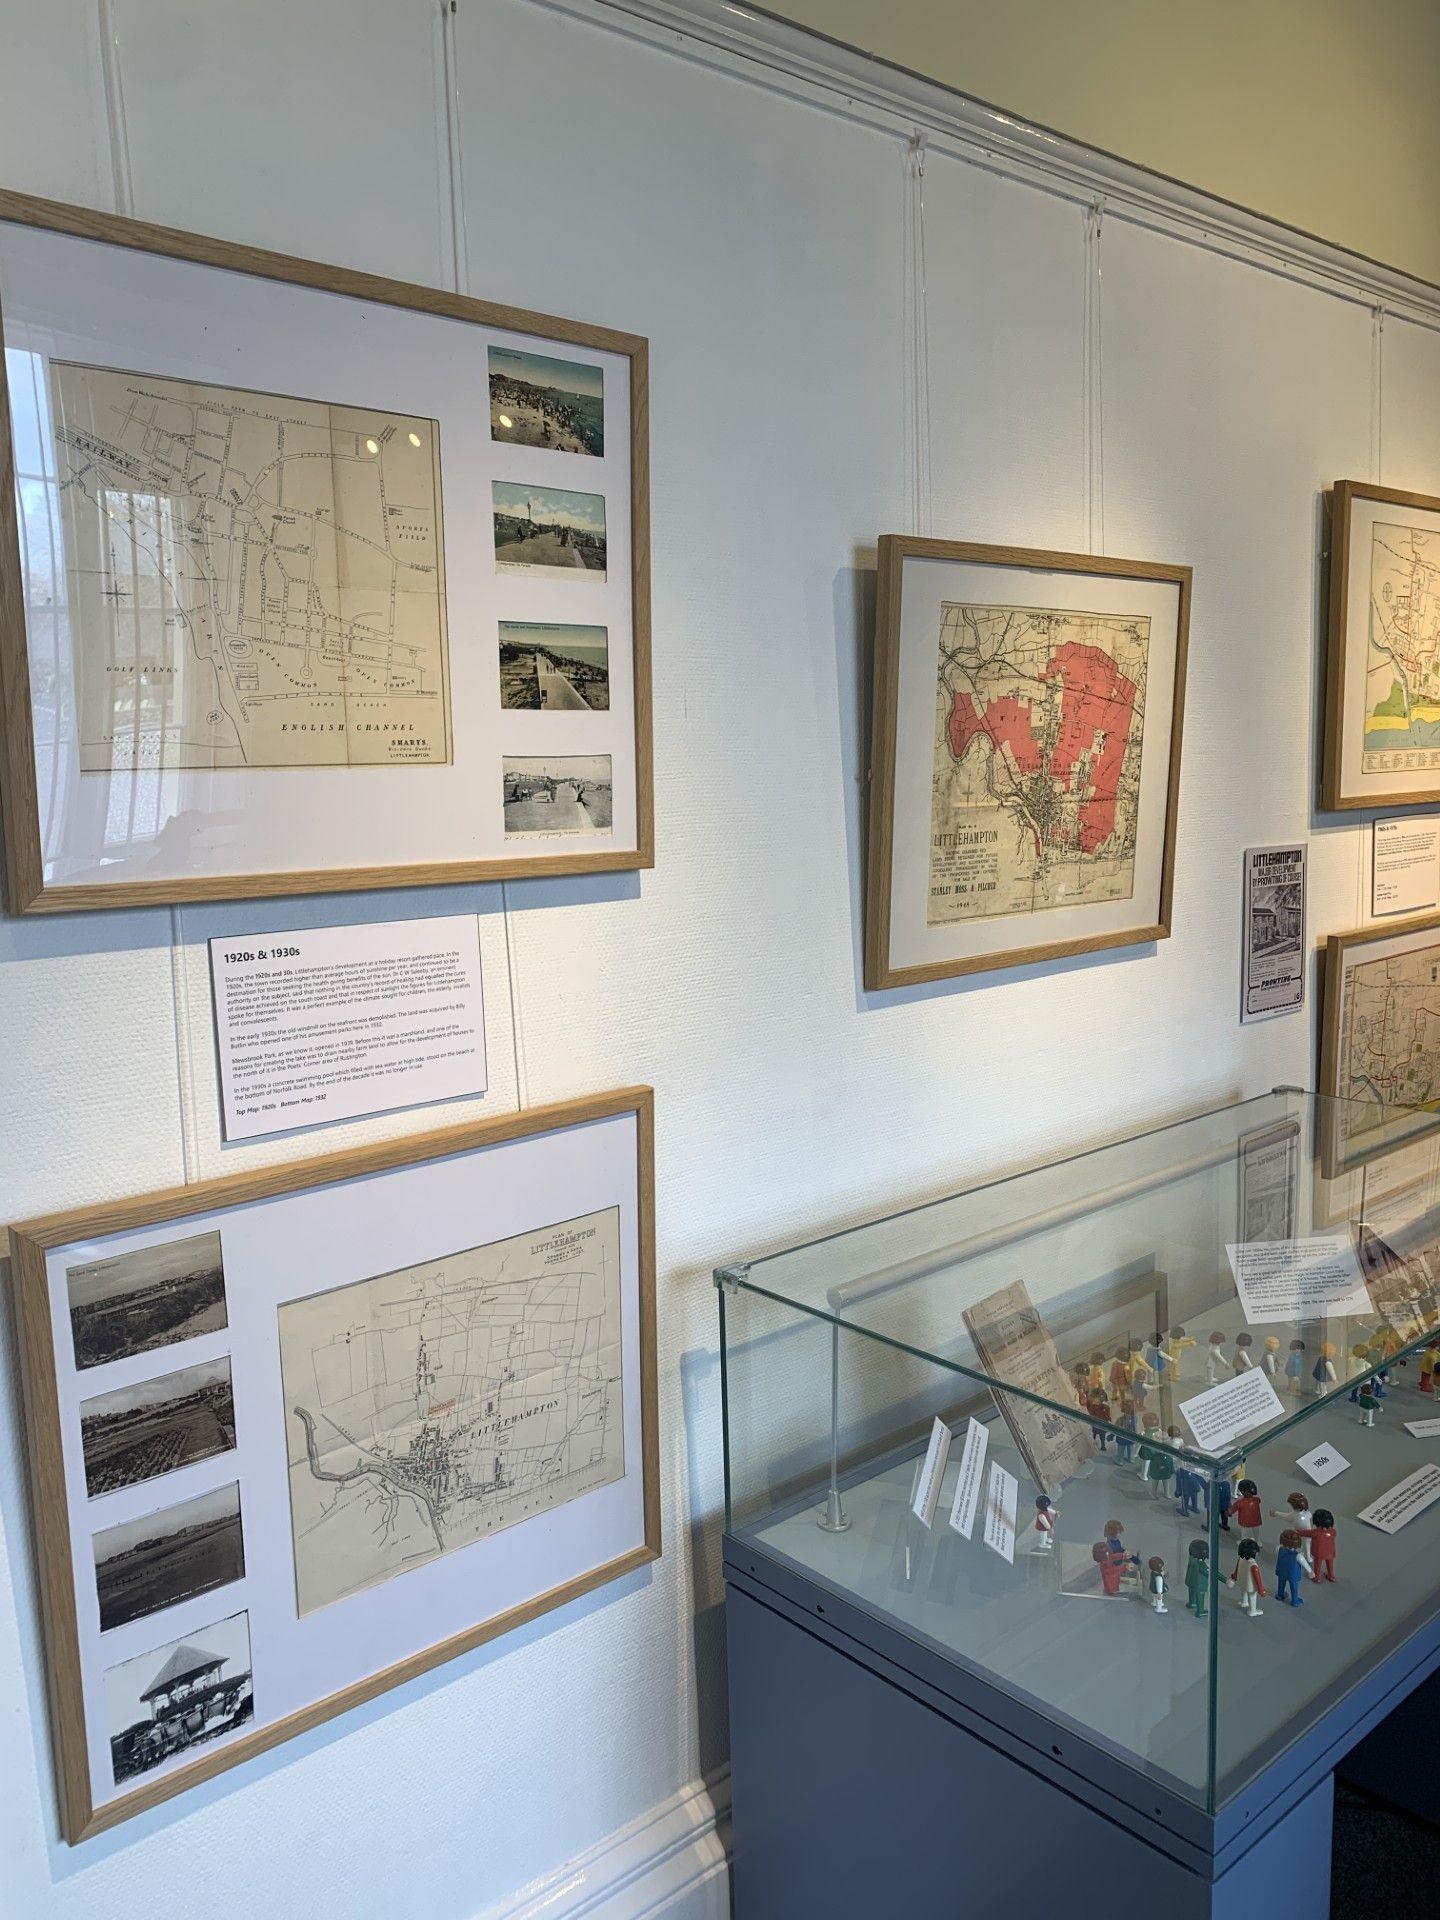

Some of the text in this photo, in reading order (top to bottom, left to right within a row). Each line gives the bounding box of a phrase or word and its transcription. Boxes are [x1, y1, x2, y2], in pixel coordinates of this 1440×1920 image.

[76, 436, 130, 468] RAILWAY
[934, 830, 998, 846] LITTLEHAMPTON
[1253, 850, 1302, 868] LITTLEHAMPTON
[1258, 874, 1282, 886] PROWTING
[224, 946, 300, 963] 1920s & 1930s
[1261, 975, 1291, 988] PROWTING
[280, 1098, 299, 1106] Bottom
[530, 1228, 596, 1256] LITTLEHAMPTON
[470, 1400, 559, 1439] LITTLEHAMPTON
[475, 1516, 504, 1532] THE
